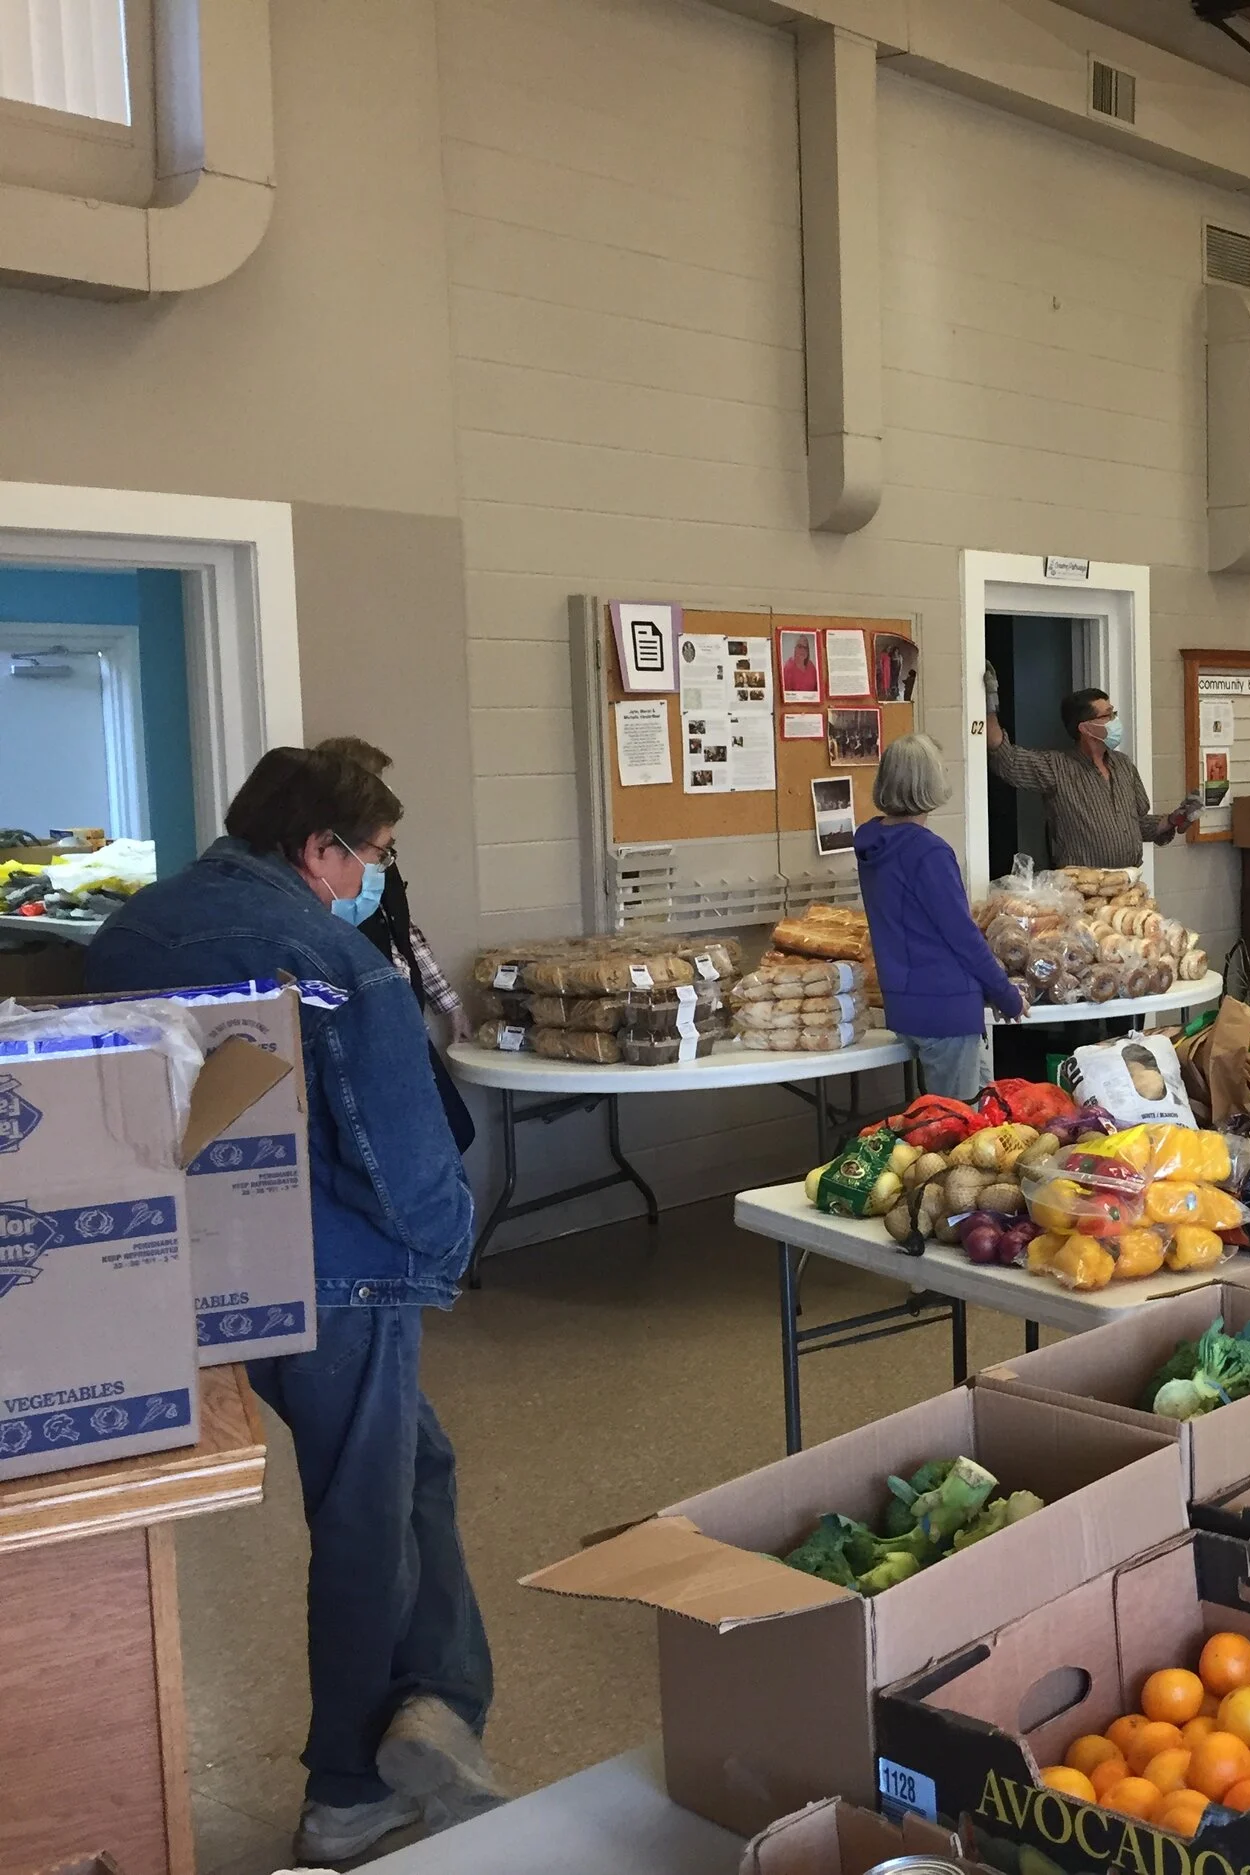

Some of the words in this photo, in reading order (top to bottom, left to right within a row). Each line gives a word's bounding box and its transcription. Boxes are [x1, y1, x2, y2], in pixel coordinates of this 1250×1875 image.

[1199, 679, 1244, 692] community
[971, 721, 985, 735] C2
[4, 1380, 125, 1413] VEGETABLES
[883, 1766, 916, 1804] 1128
